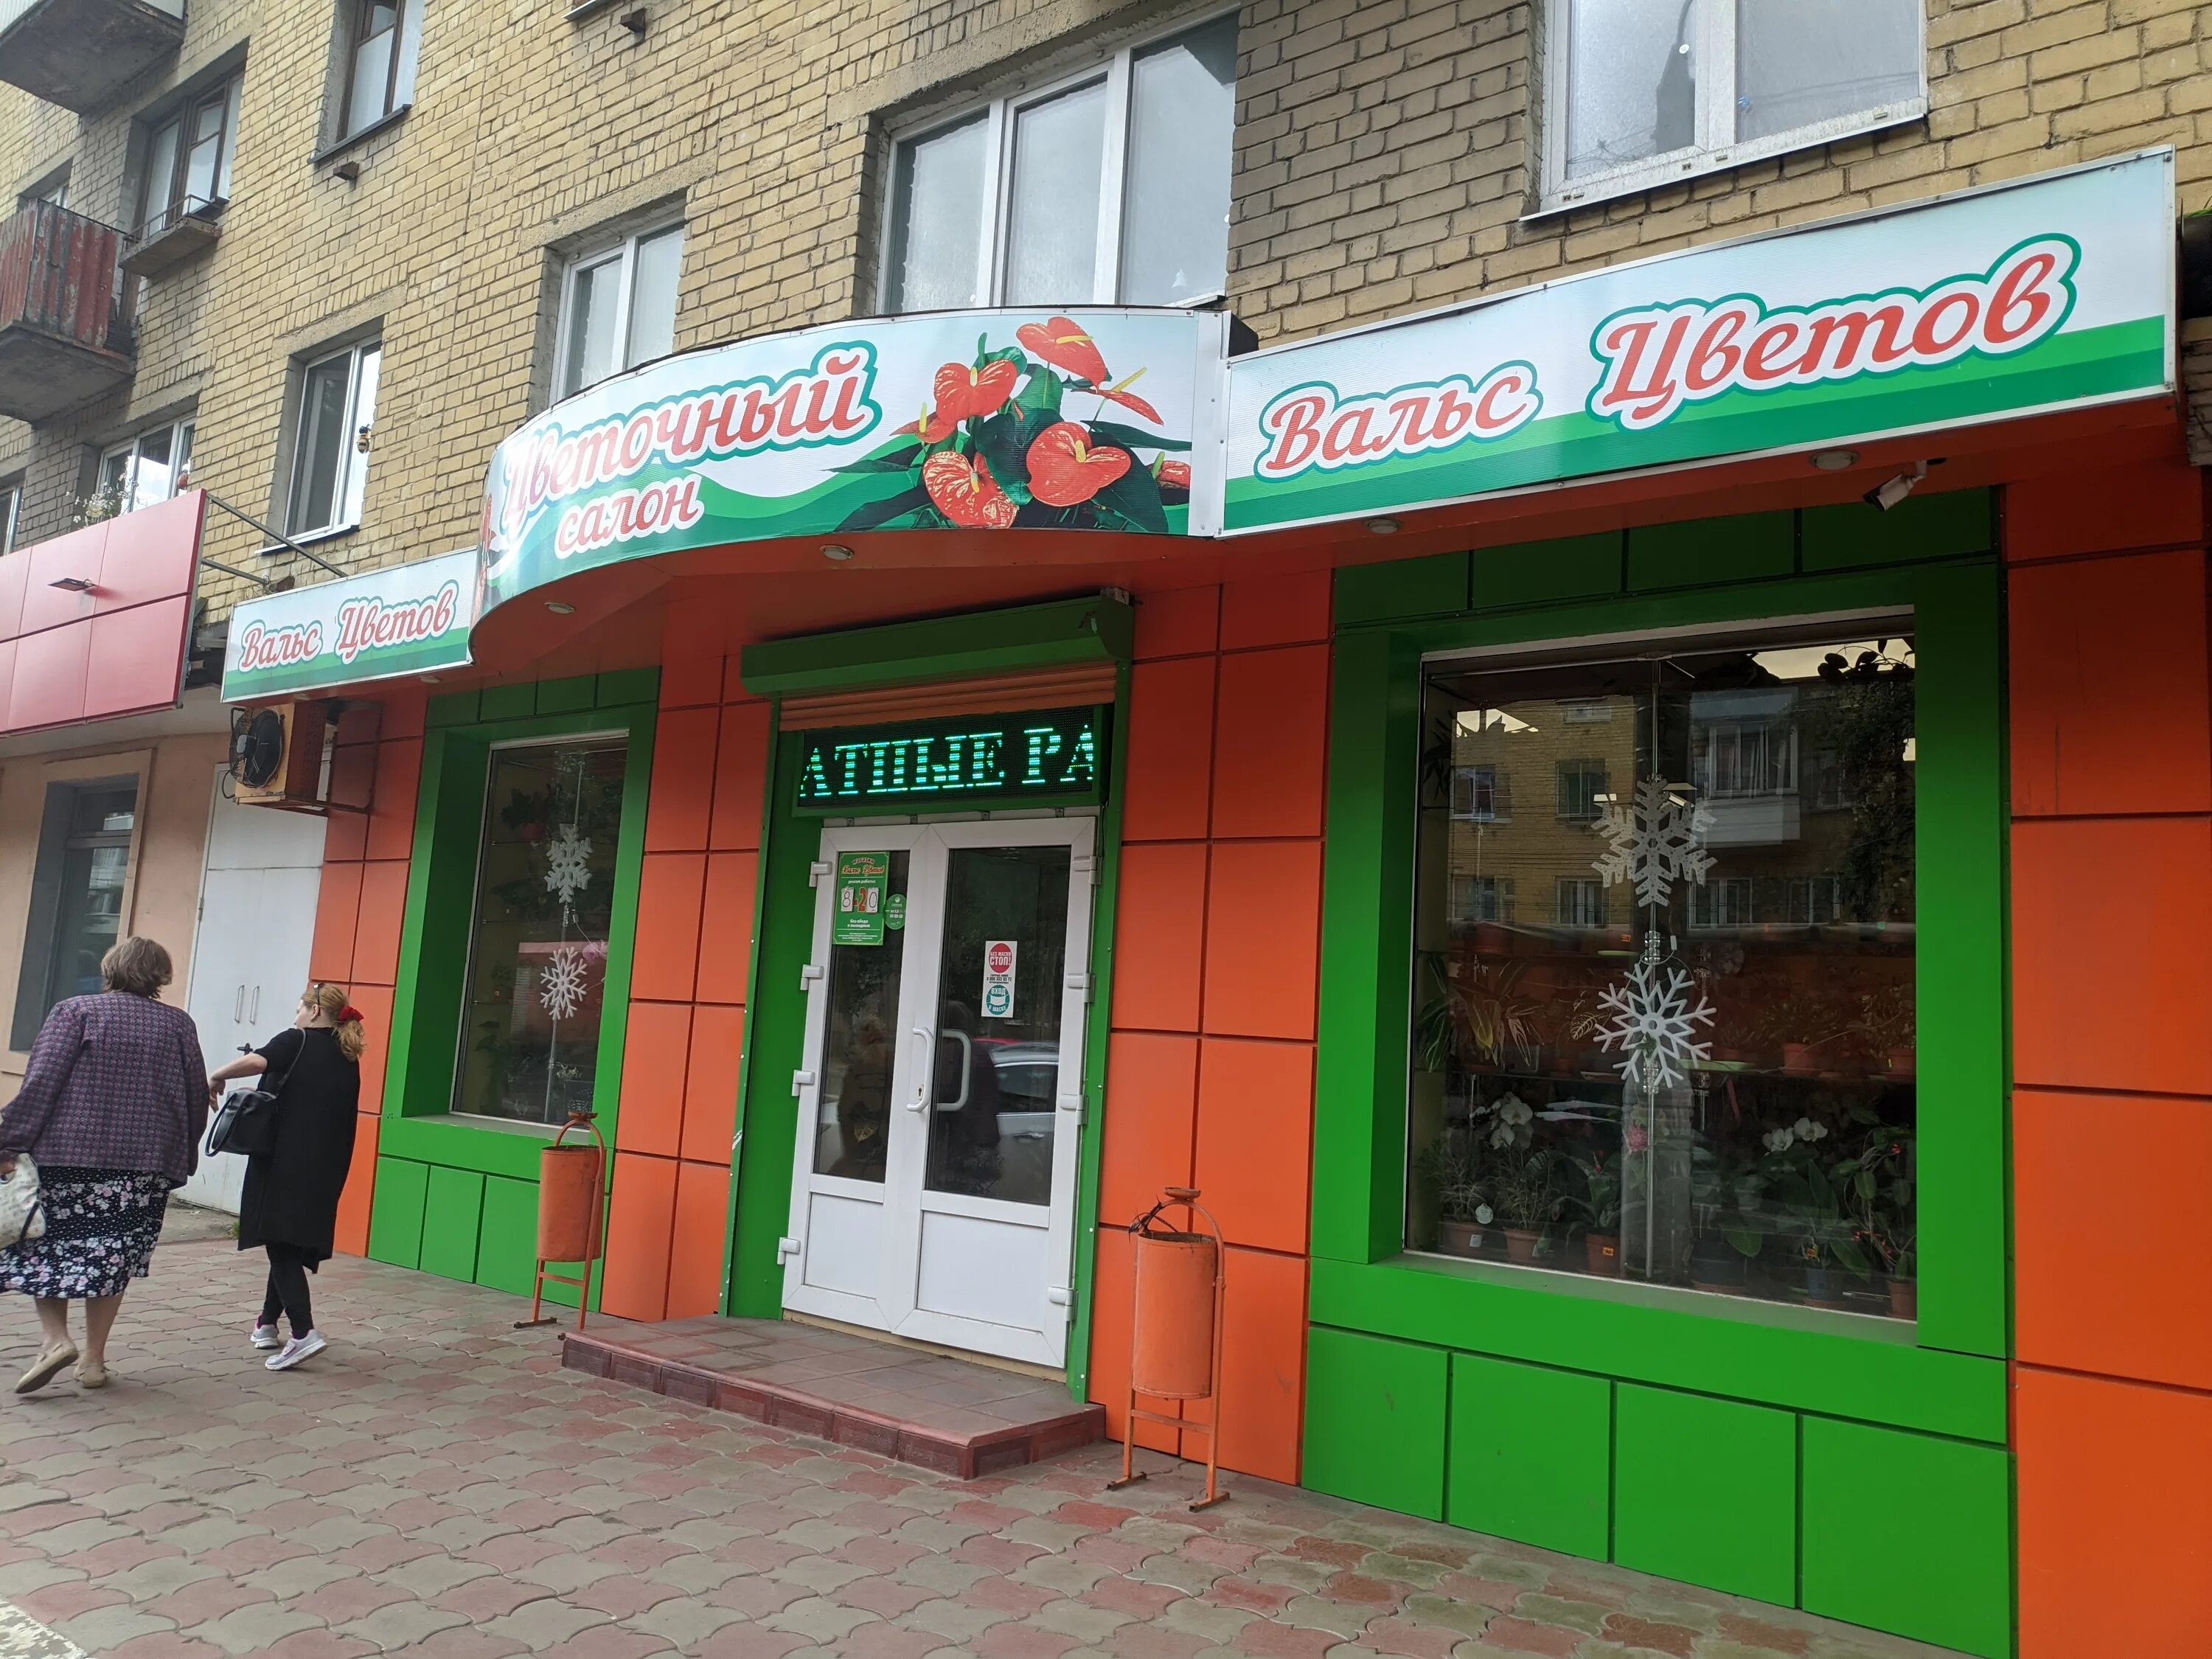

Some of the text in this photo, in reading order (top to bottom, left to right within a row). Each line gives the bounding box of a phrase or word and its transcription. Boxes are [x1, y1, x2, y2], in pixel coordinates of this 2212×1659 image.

[1263, 251, 2059, 472] Вальс Цветов
[501, 352, 867, 528] Цветочный
[557, 480, 699, 554] салон
[241, 588, 453, 669] Вальс Цветов
[990, 956, 1011, 966] СТОП!
[991, 988, 1006, 996] ВХОД
